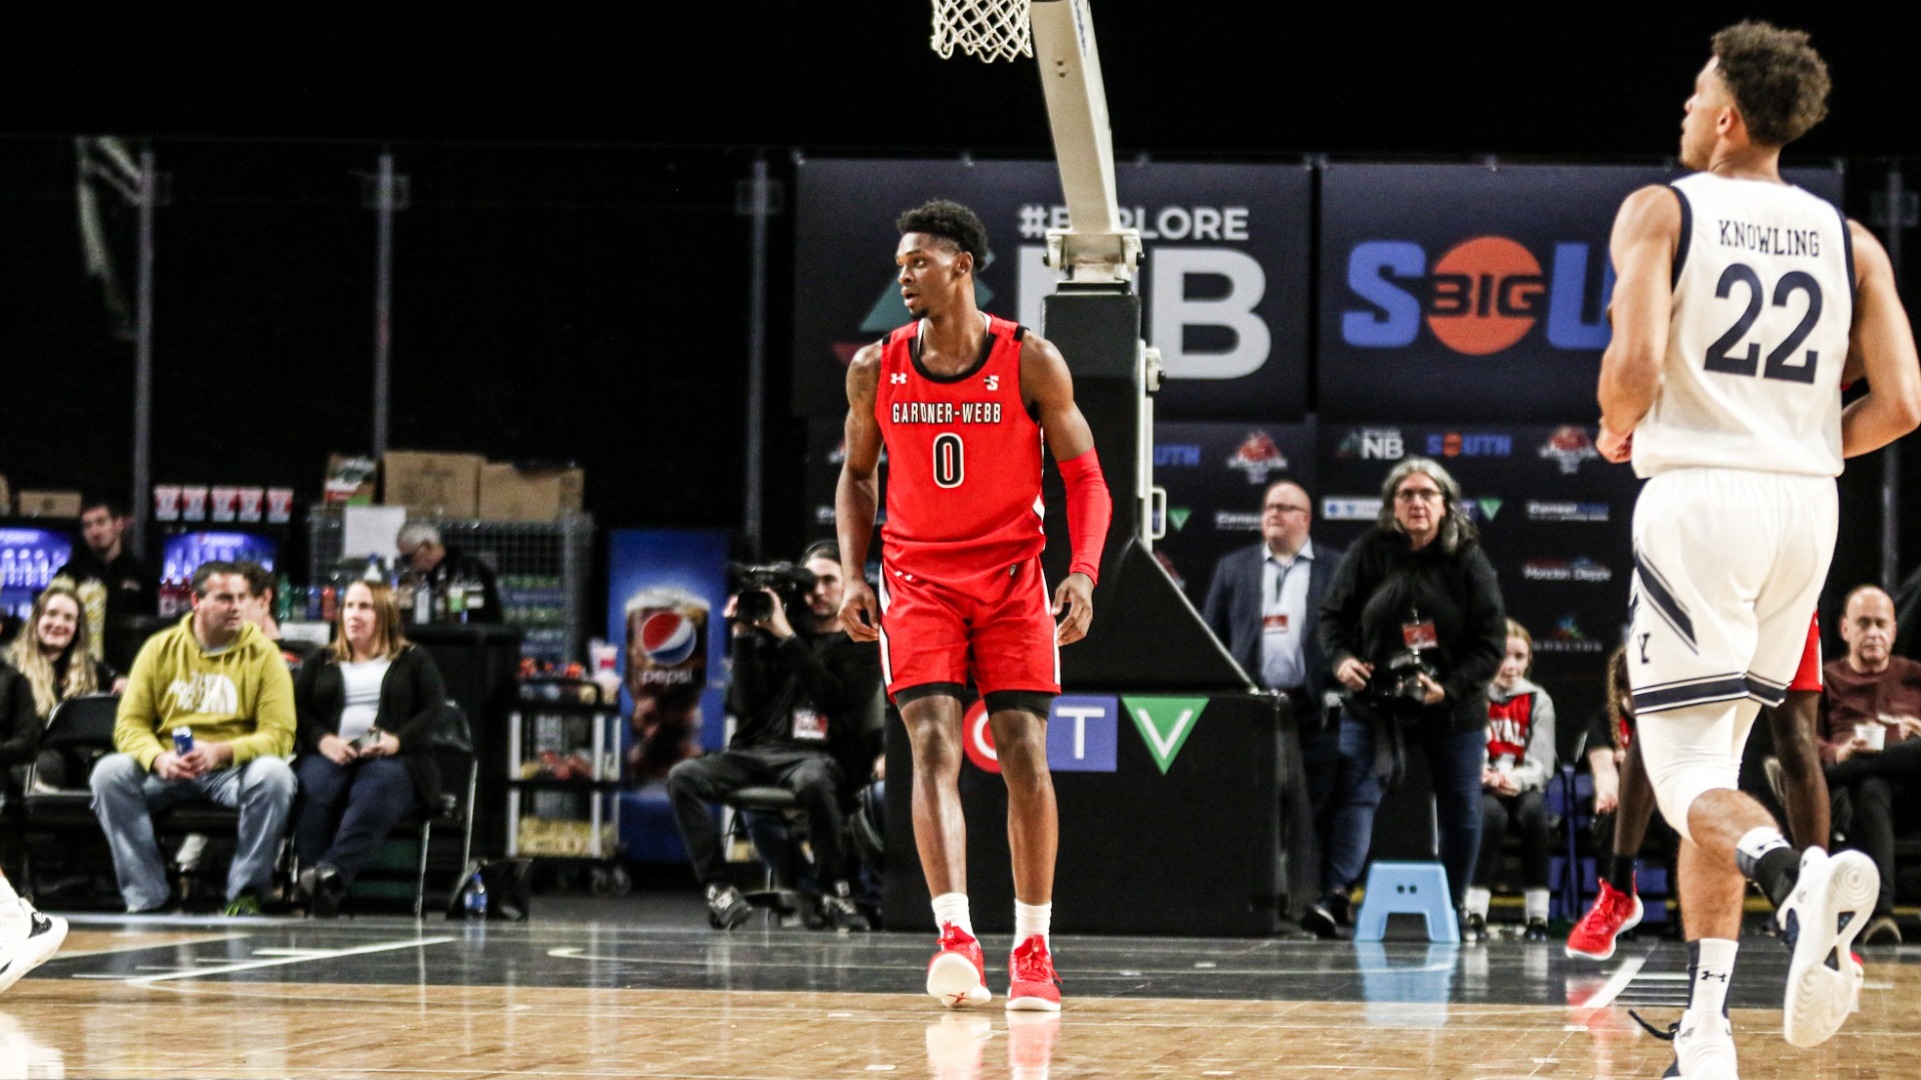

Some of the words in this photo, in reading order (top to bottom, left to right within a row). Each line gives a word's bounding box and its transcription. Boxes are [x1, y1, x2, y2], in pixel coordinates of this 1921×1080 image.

[1019, 204, 1250, 240] #ELORE
[1718, 219, 1820, 257] KNOWLING
[1429, 274, 1546, 317] BIG
[1703, 262, 1823, 385] 22
[892, 402, 1001, 423] GARDNER-WEBB
[932, 431, 965, 489] 0
[1361, 438, 1405, 459] NB
[642, 668, 692, 686] pepsi
